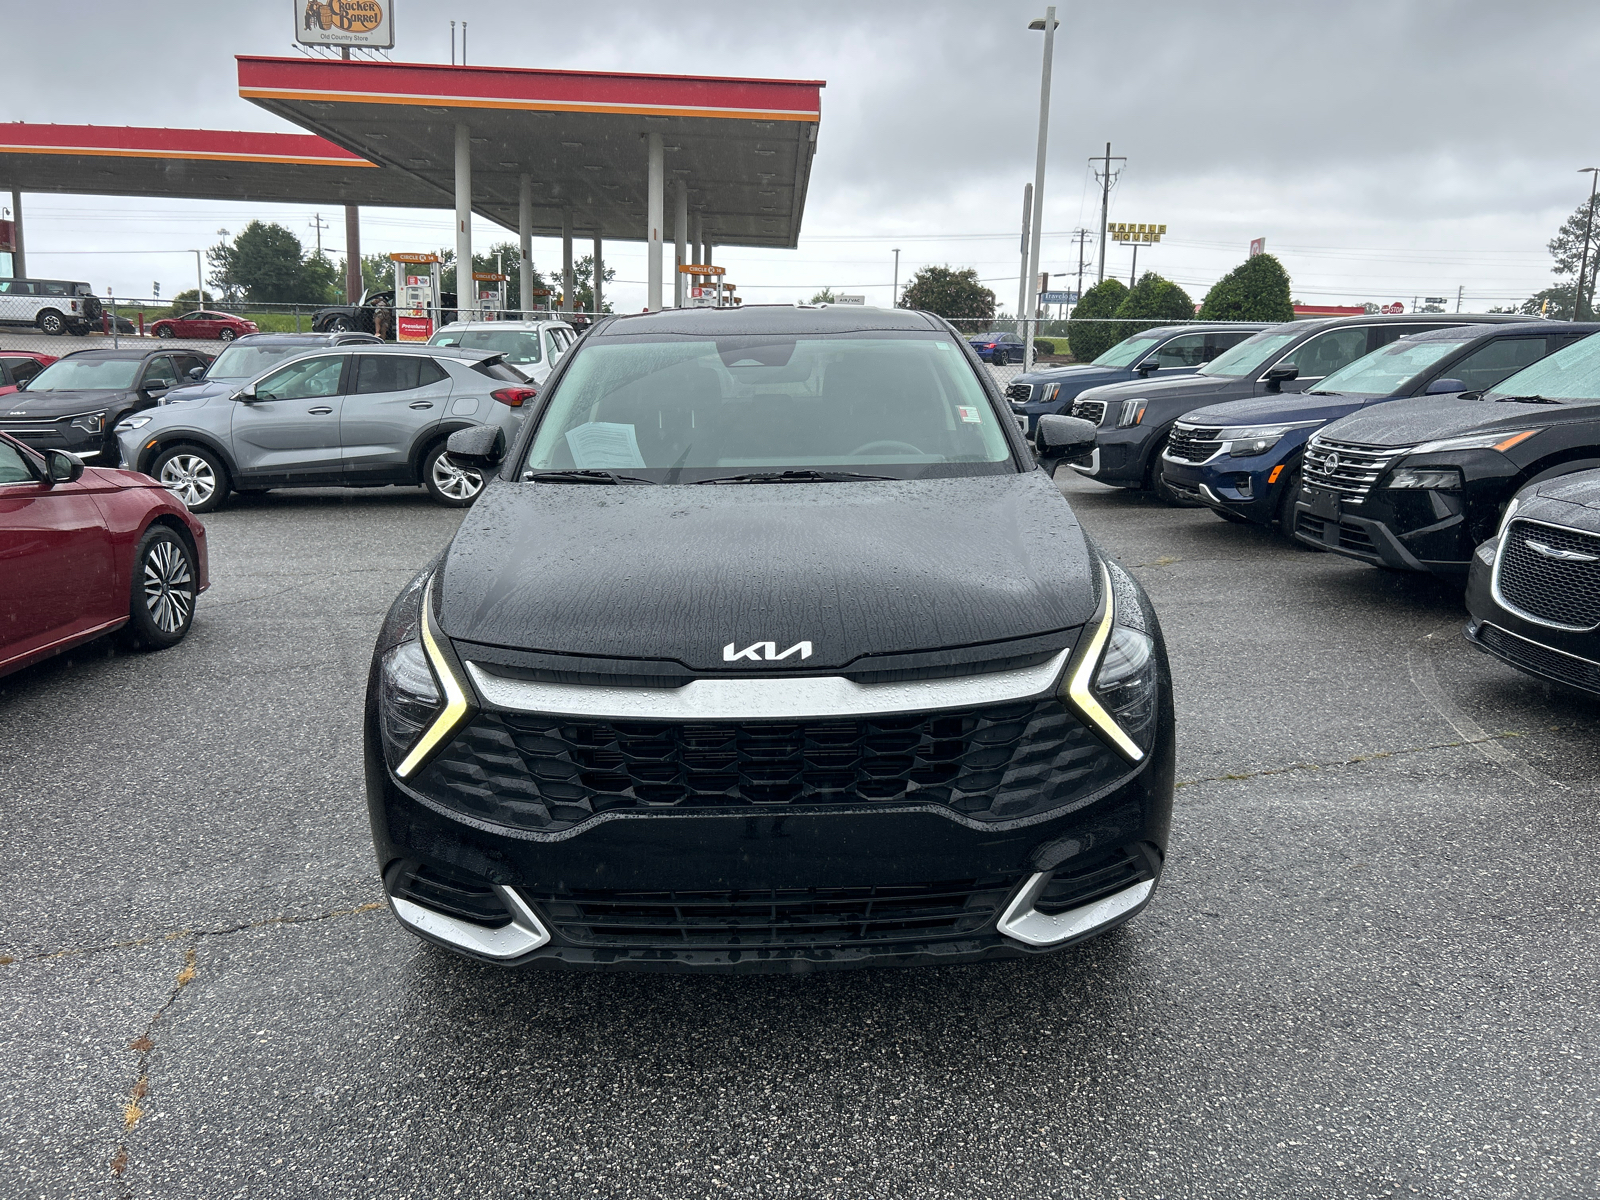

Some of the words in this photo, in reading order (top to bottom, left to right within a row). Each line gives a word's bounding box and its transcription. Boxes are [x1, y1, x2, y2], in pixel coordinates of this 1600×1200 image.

[340, 10, 378, 30] Barrel
[331, 34, 352, 42] Country
[1109, 224, 1165, 233] WAFFLE
[1113, 233, 1159, 241] HOUSE
[723, 640, 812, 661] KIA
